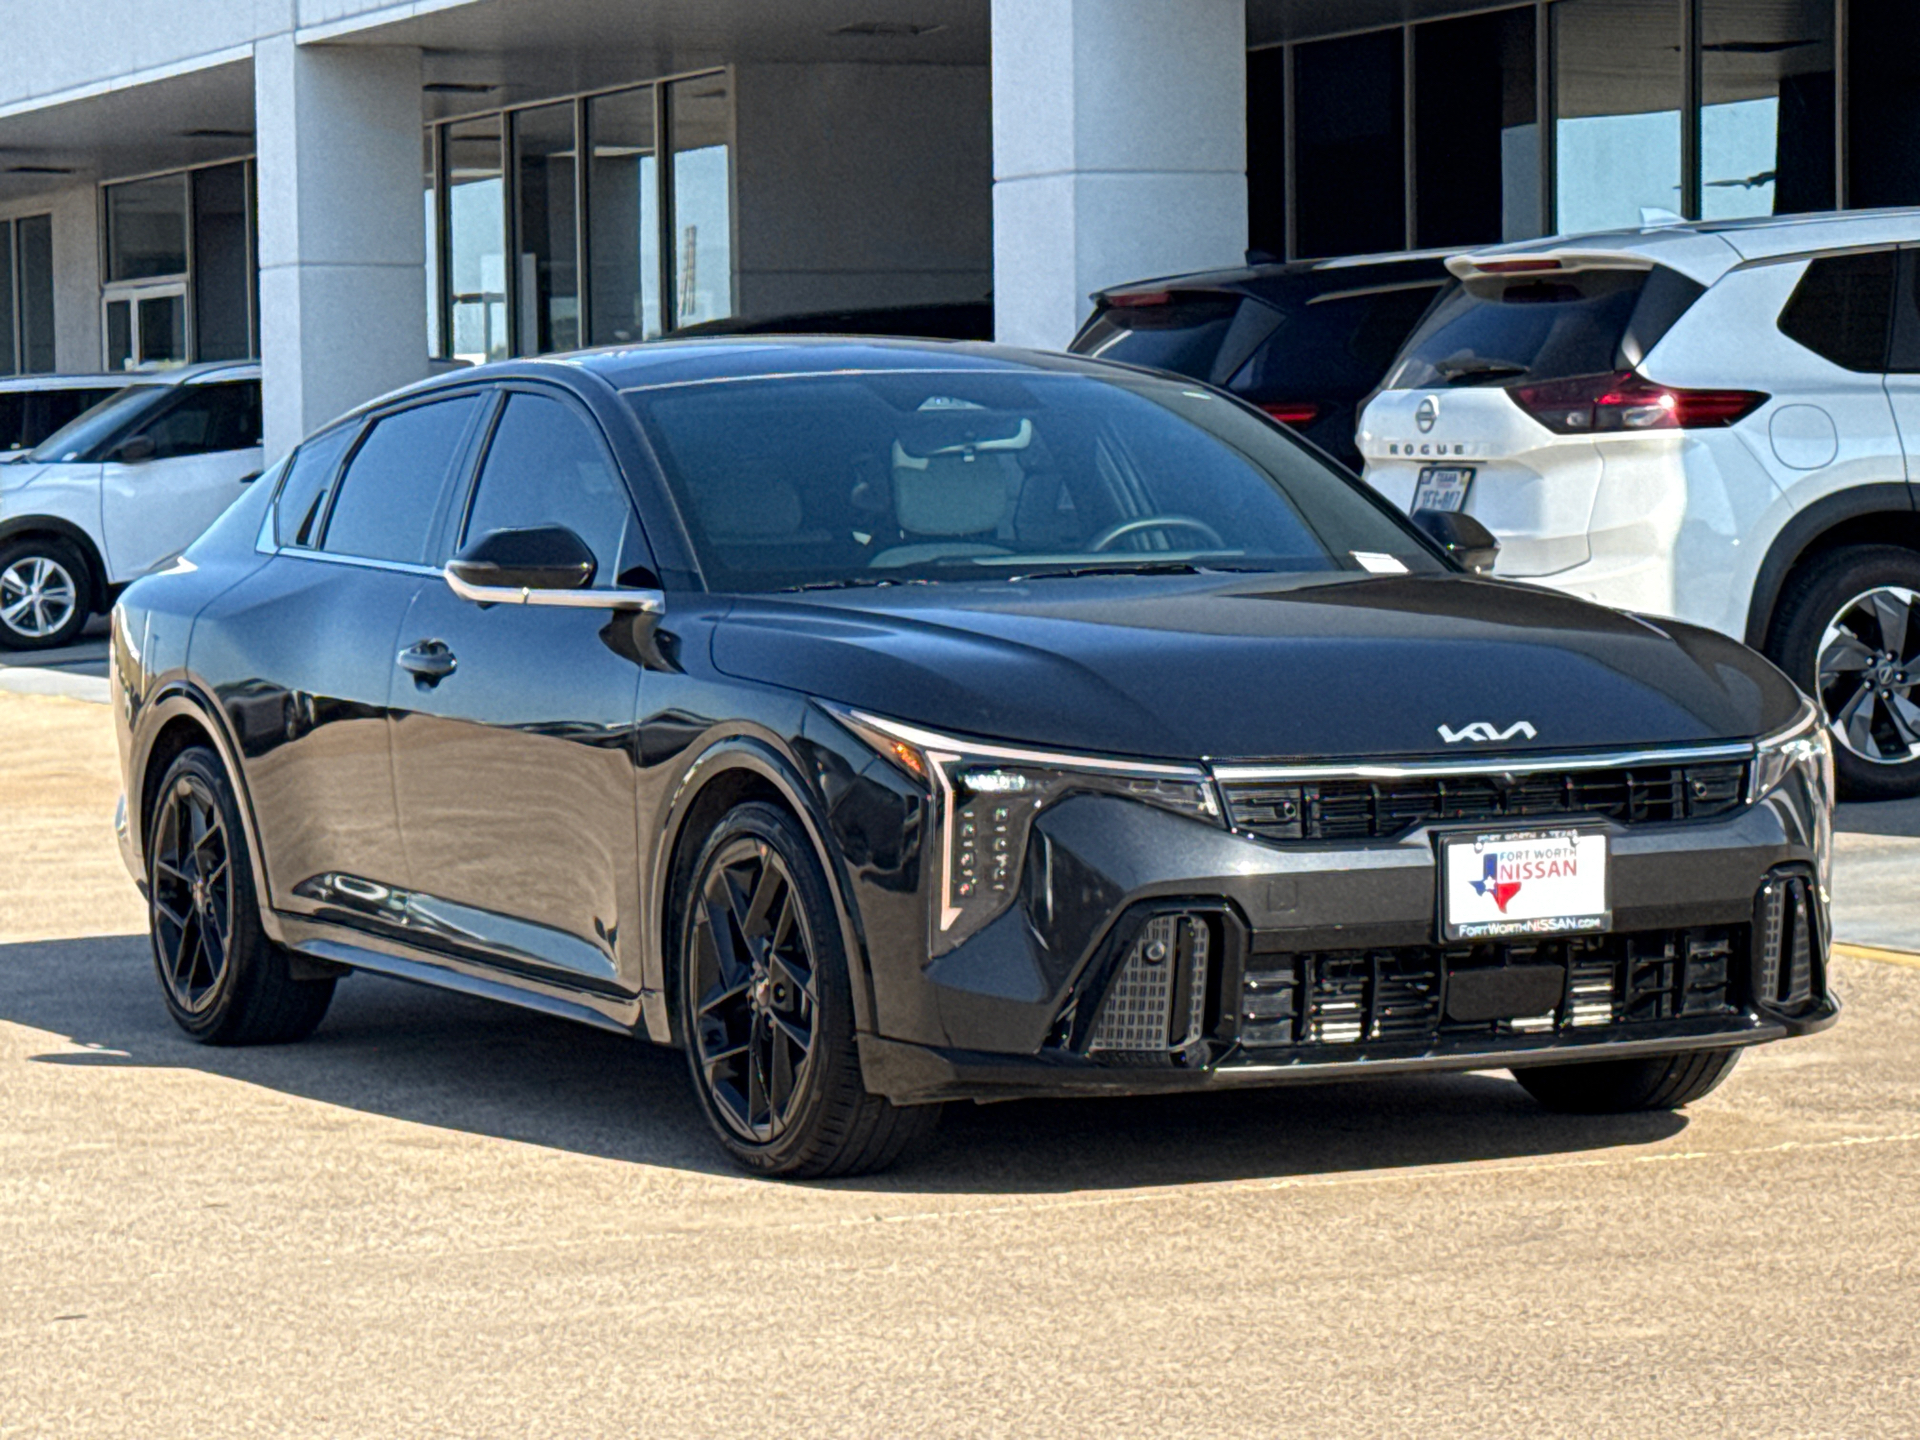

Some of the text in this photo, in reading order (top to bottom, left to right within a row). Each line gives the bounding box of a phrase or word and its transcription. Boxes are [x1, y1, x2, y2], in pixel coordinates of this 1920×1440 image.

[1389, 444, 1465, 455] ROGUE
[1437, 721, 1538, 743] KIA
[1500, 848, 1577, 862] FORT WORTH
[1500, 859, 1577, 880] NISSAN
